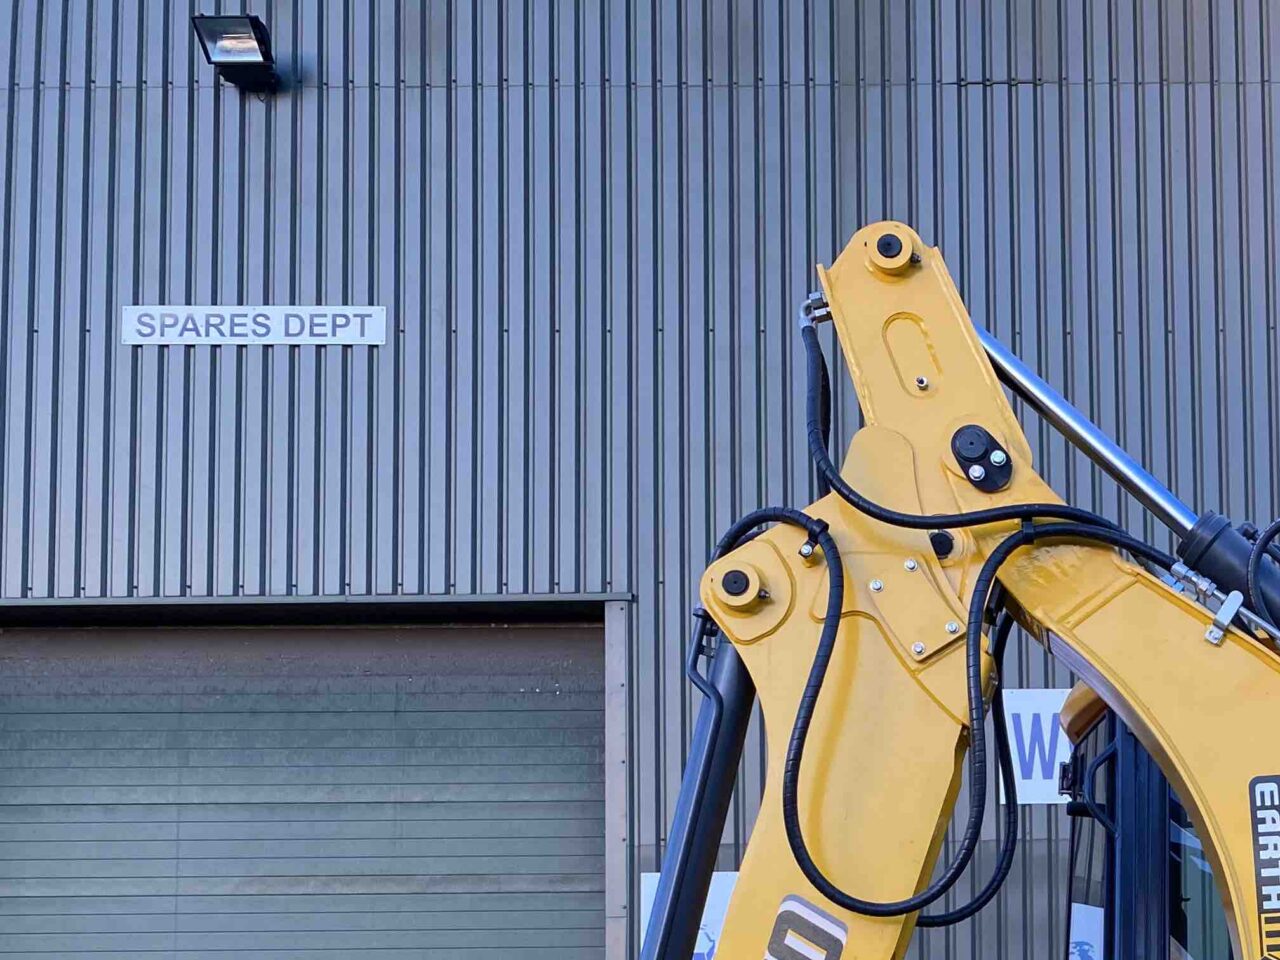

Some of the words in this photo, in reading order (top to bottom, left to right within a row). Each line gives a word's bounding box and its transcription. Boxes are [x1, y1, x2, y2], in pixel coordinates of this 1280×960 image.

[136, 312, 272, 338] SPARES
[284, 312, 373, 338] DEPT
[1011, 712, 1068, 780] W
